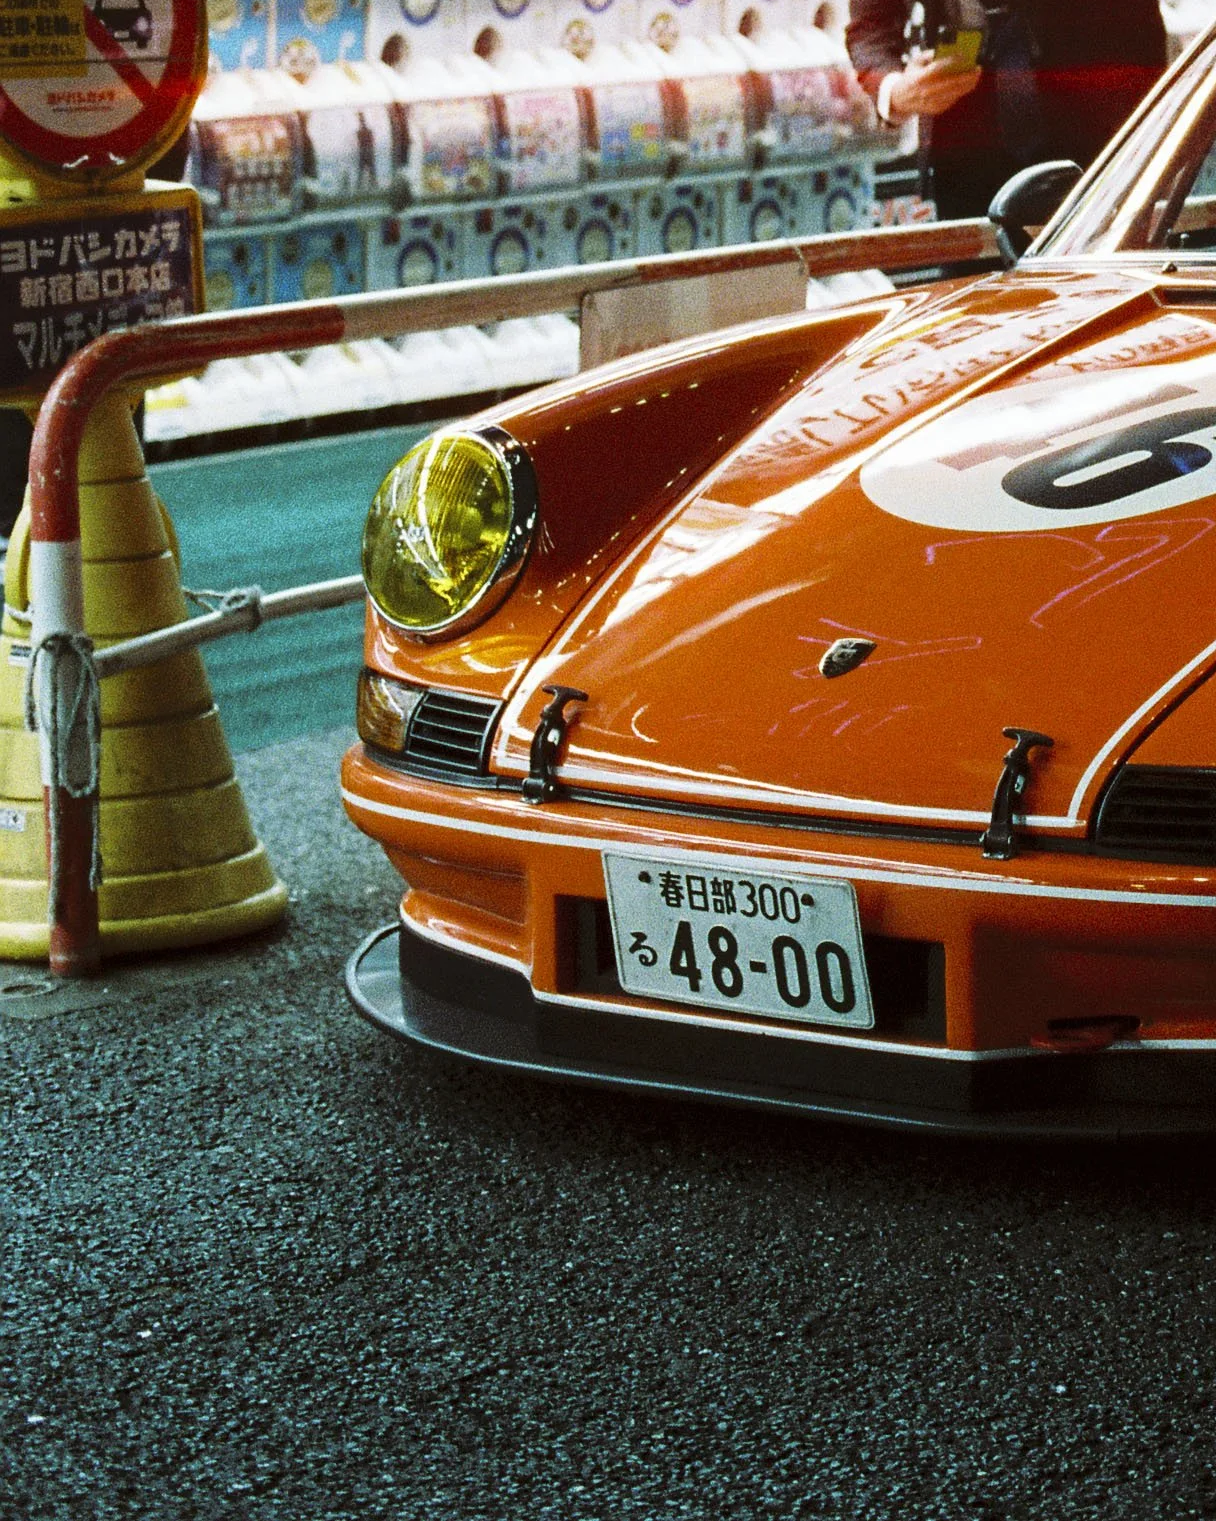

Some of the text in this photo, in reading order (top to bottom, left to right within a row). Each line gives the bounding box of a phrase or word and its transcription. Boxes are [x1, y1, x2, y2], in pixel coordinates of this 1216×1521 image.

[0, 220, 182, 273] ヨドバシカメラ
[19, 260, 172, 310] 新宿西口本店
[628, 920, 857, 1014] る 48-00
